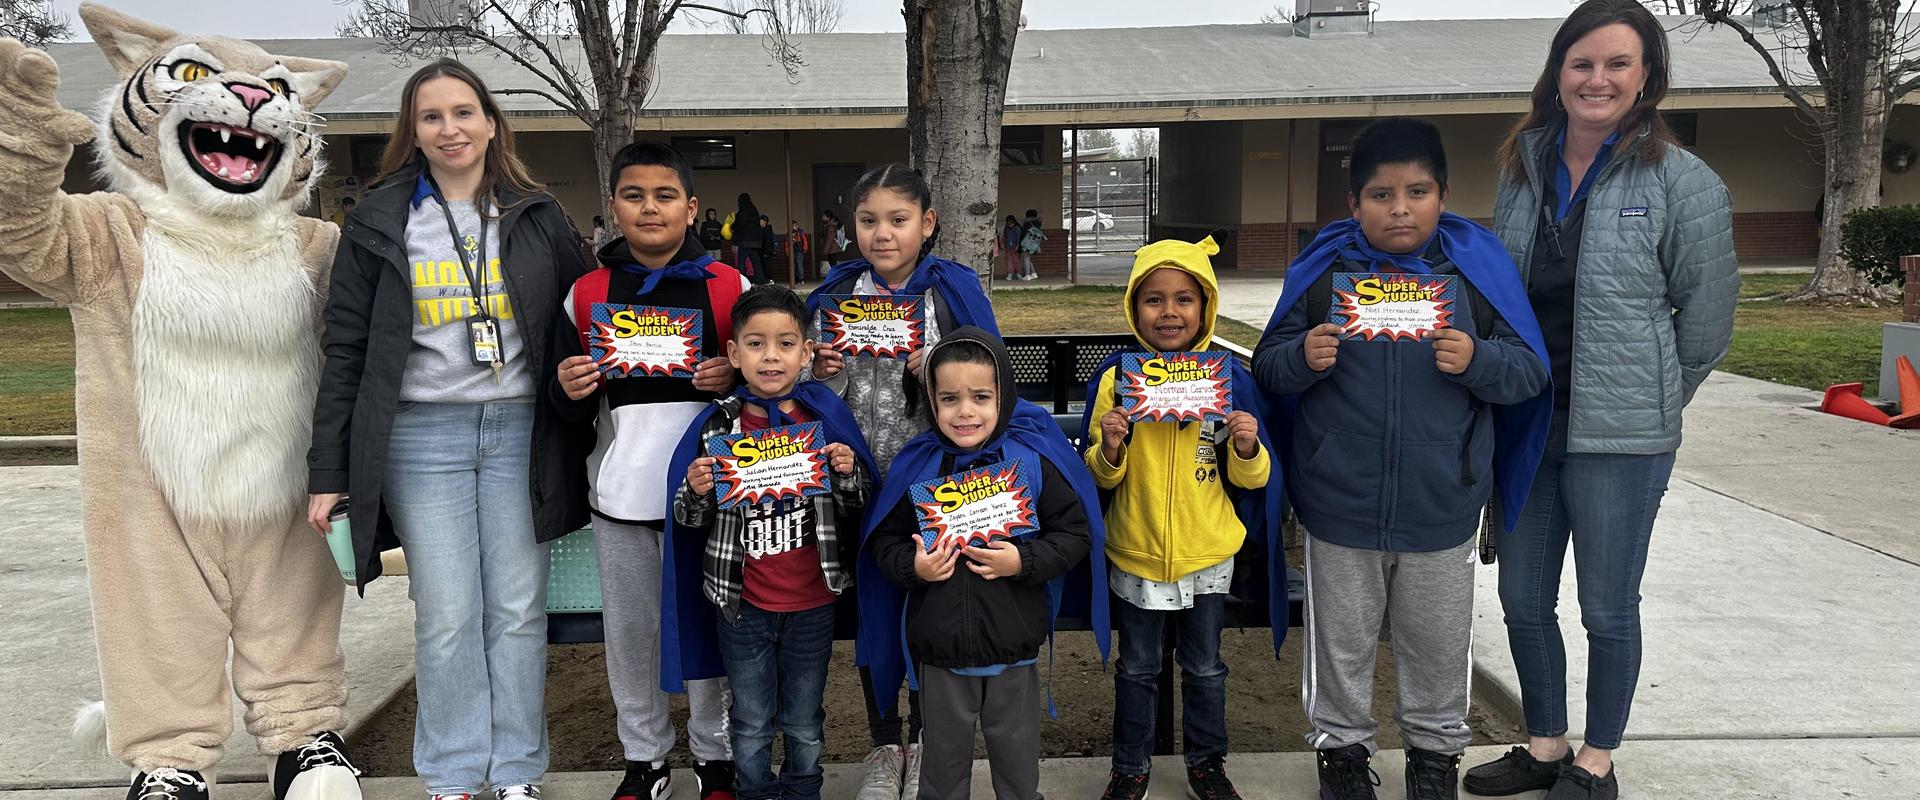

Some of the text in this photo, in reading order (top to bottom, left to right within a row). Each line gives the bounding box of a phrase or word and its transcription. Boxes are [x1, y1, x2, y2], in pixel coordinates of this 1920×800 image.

[1355, 277, 1418, 305] SUPER
[612, 309, 669, 338] SUPER
[839, 298, 893, 323] SUPER
[882, 324, 896, 332] Cruz
[1142, 357, 1198, 386] SUPER
[1155, 385, 1188, 394] Norman
[732, 435, 789, 468] SUPER
[744, 462, 804, 476] Julian Hernandez
[934, 475, 992, 513] SUPER
[747, 508, 806, 560] QUIT
